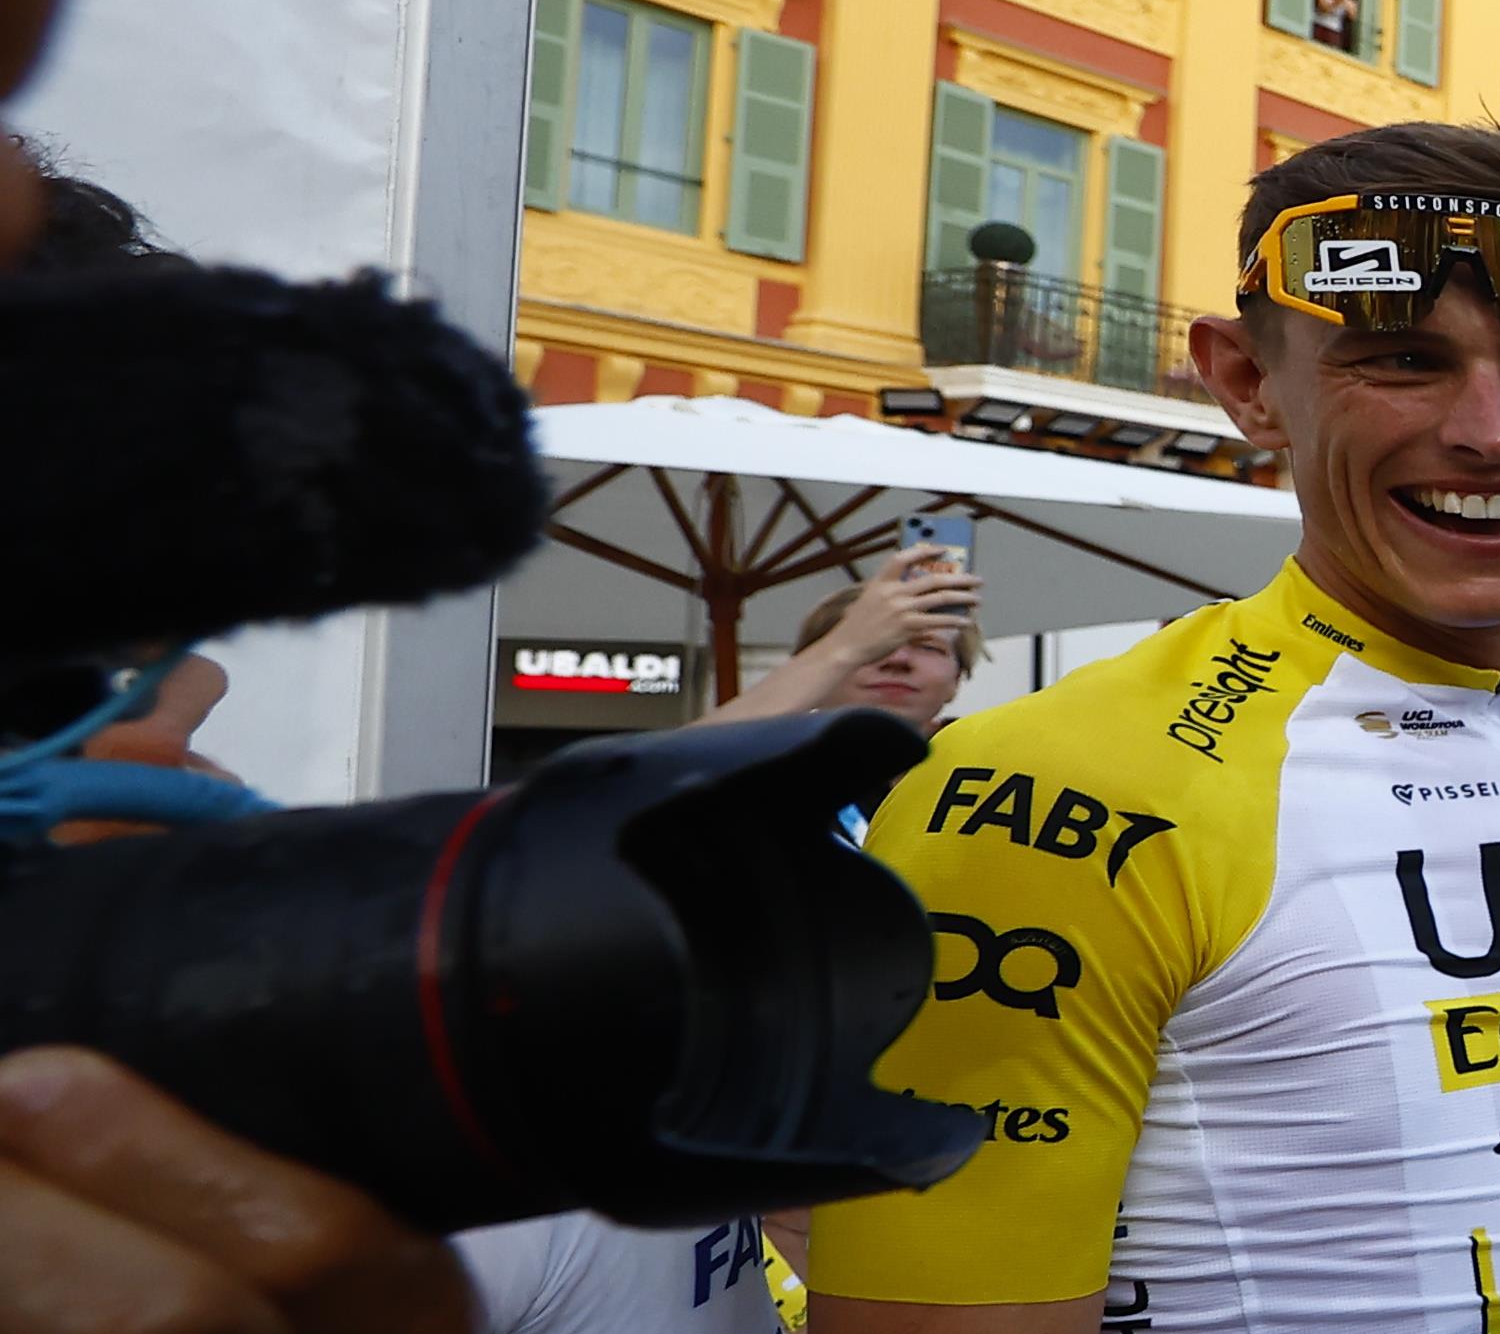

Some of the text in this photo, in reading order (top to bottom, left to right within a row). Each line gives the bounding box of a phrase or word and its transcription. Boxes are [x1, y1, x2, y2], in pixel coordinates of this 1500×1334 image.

[514, 648, 681, 678] UBALDI
[1301, 613, 1366, 653] Emirates
[1166, 639, 1282, 764] presight
[1402, 710, 1434, 722] UCI
[926, 768, 1110, 859] FAB
[1419, 782, 1500, 801] PISSEI
[927, 912, 1082, 1020] DQ
[693, 1215, 765, 1308] FA
